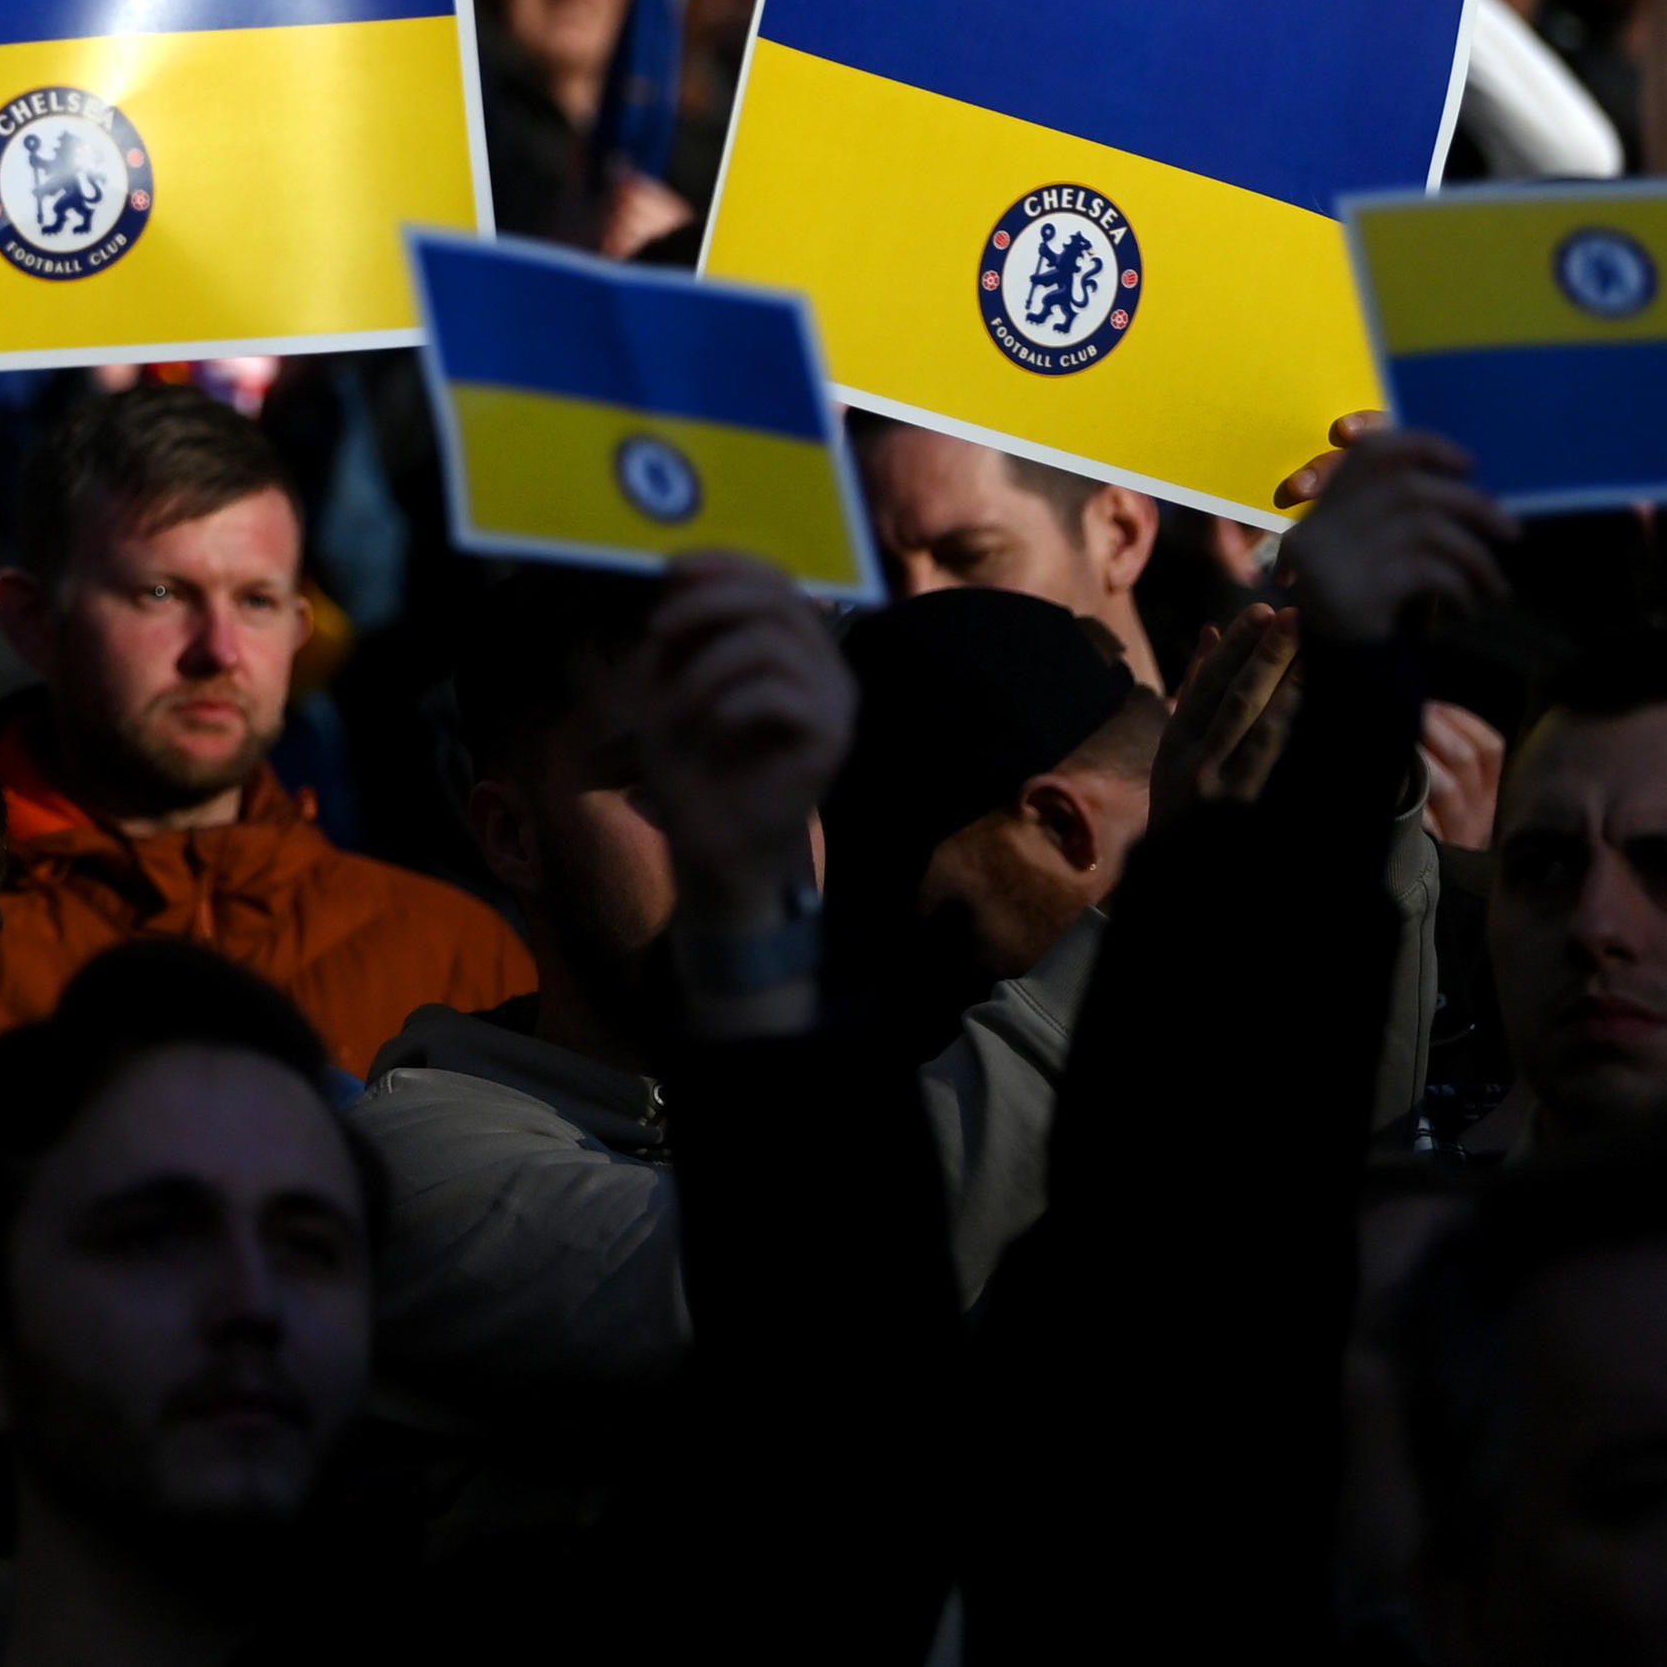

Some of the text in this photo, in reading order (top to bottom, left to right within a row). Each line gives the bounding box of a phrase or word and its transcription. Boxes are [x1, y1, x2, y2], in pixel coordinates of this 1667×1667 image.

[1024, 188, 1127, 245] CHELSEA
[6, 233, 128, 273] FOOTBALL CLUB
[991, 317, 1097, 367] FOOTBALL CLUB
